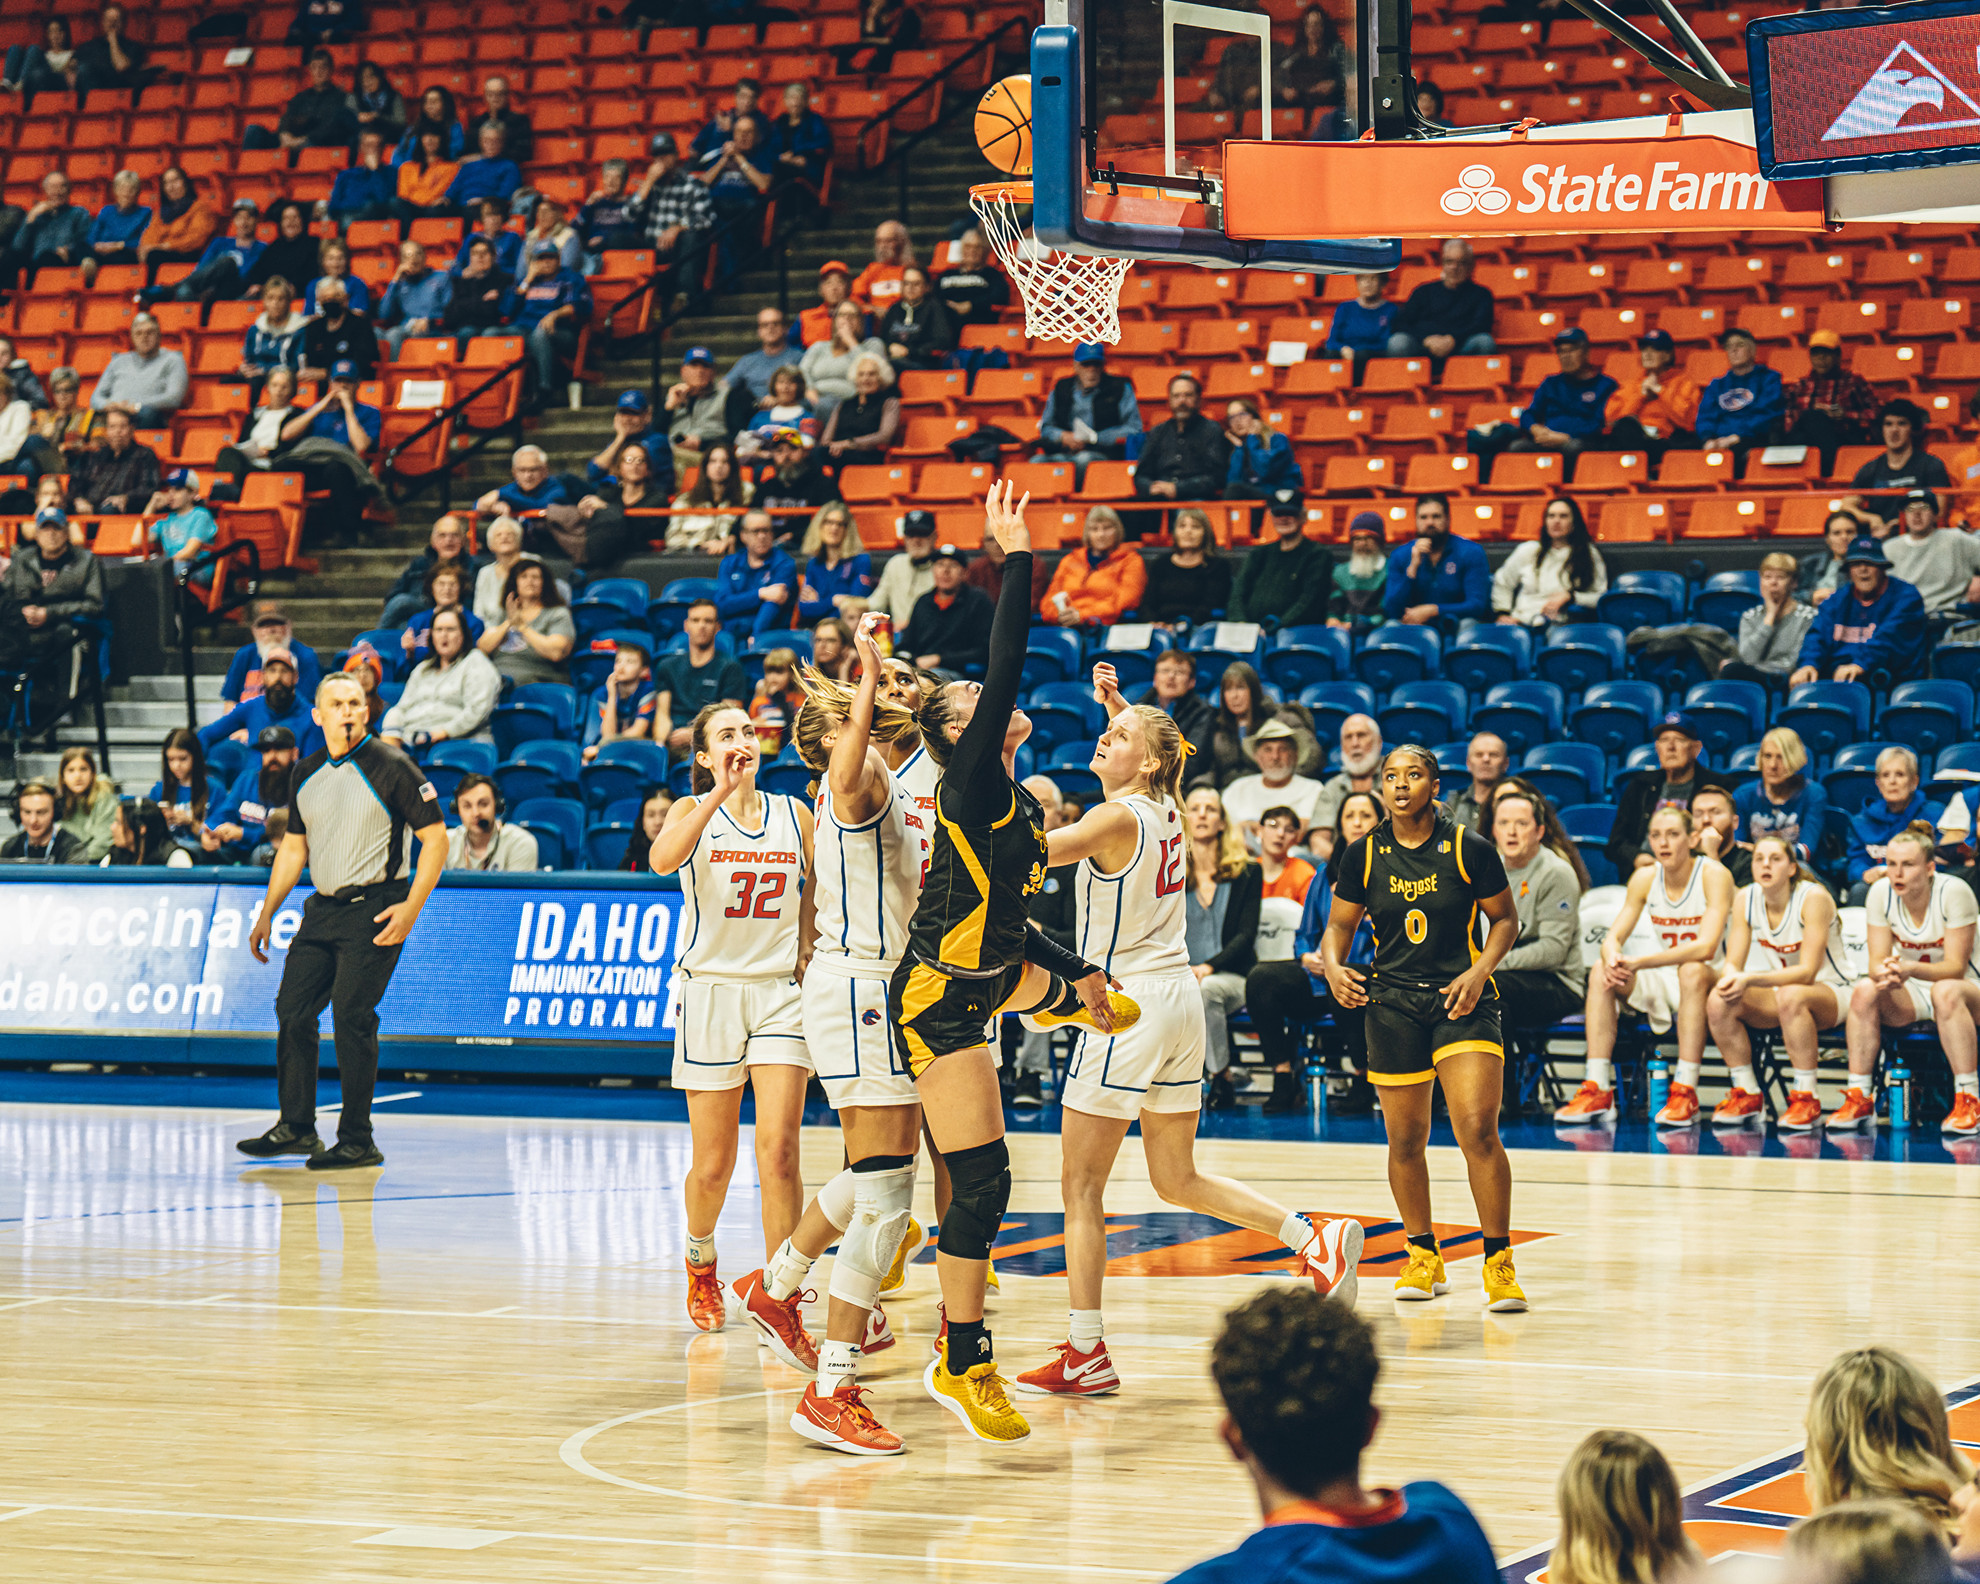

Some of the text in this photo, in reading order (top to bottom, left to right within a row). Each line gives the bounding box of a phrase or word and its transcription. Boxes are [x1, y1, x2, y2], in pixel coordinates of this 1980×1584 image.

[710, 850, 797, 865] BRONCOS
[1155, 832, 1185, 899] 12
[724, 871, 787, 919] 32
[18, 894, 304, 950] Vaccinate
[515, 901, 671, 963] IDAHO
[1405, 908, 1428, 945] 0
[509, 963, 662, 996] IMMUNIZATION
[503, 996, 658, 1028] PROGRAM
